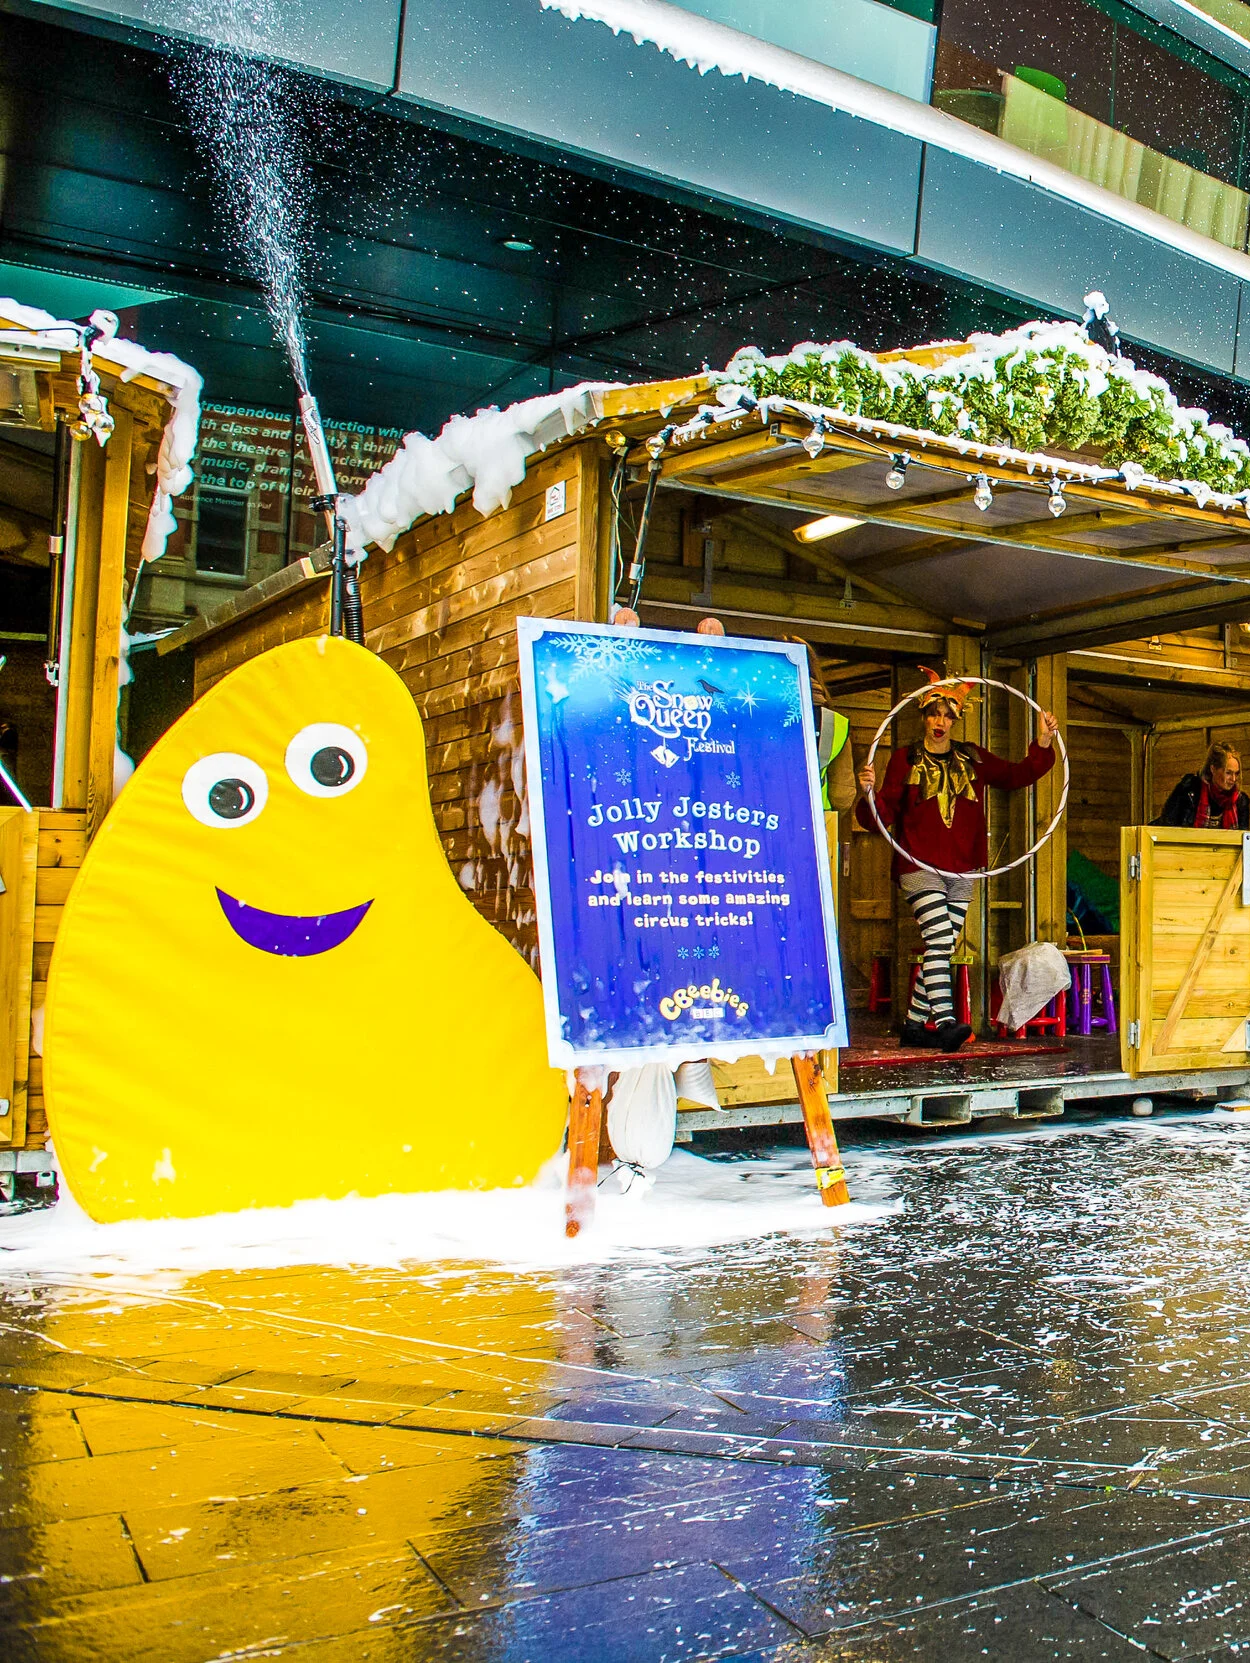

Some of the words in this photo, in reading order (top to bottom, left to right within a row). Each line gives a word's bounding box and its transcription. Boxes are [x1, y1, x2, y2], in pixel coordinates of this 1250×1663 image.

[200, 401, 292, 422] tremendous
[296, 415, 374, 434] pduction
[221, 422, 258, 436] class
[262, 428, 292, 440] and
[295, 433, 346, 450] qity,
[351, 441, 360, 450] a
[202, 437, 227, 450] the
[232, 440, 289, 458] theatre.
[294, 450, 305, 460] A
[332, 455, 382, 470] nderful
[200, 458, 250, 472] music,
[254, 462, 306, 480] drama,
[200, 473, 226, 487] the
[230, 478, 256, 490] top
[260, 481, 277, 491] of
[279, 483, 314, 496] their
[216, 497, 244, 506] Member
[636, 680, 653, 691] The
[652, 680, 712, 711] Snow
[629, 693, 711, 740] Queen
[683, 736, 736, 762] Festival
[587, 798, 662, 827] Jolly
[673, 796, 780, 830] Jesters
[612, 828, 760, 859] Workshop
[590, 870, 630, 885] Join
[636, 870, 653, 884] in
[659, 870, 688, 884] the
[695, 870, 785, 884] festivities
[588, 893, 621, 906] and
[626, 892, 672, 906] learn
[678, 893, 720, 905] some
[726, 890, 790, 906] amazing
[634, 914, 689, 928] circus
[695, 911, 754, 926] tricks!
